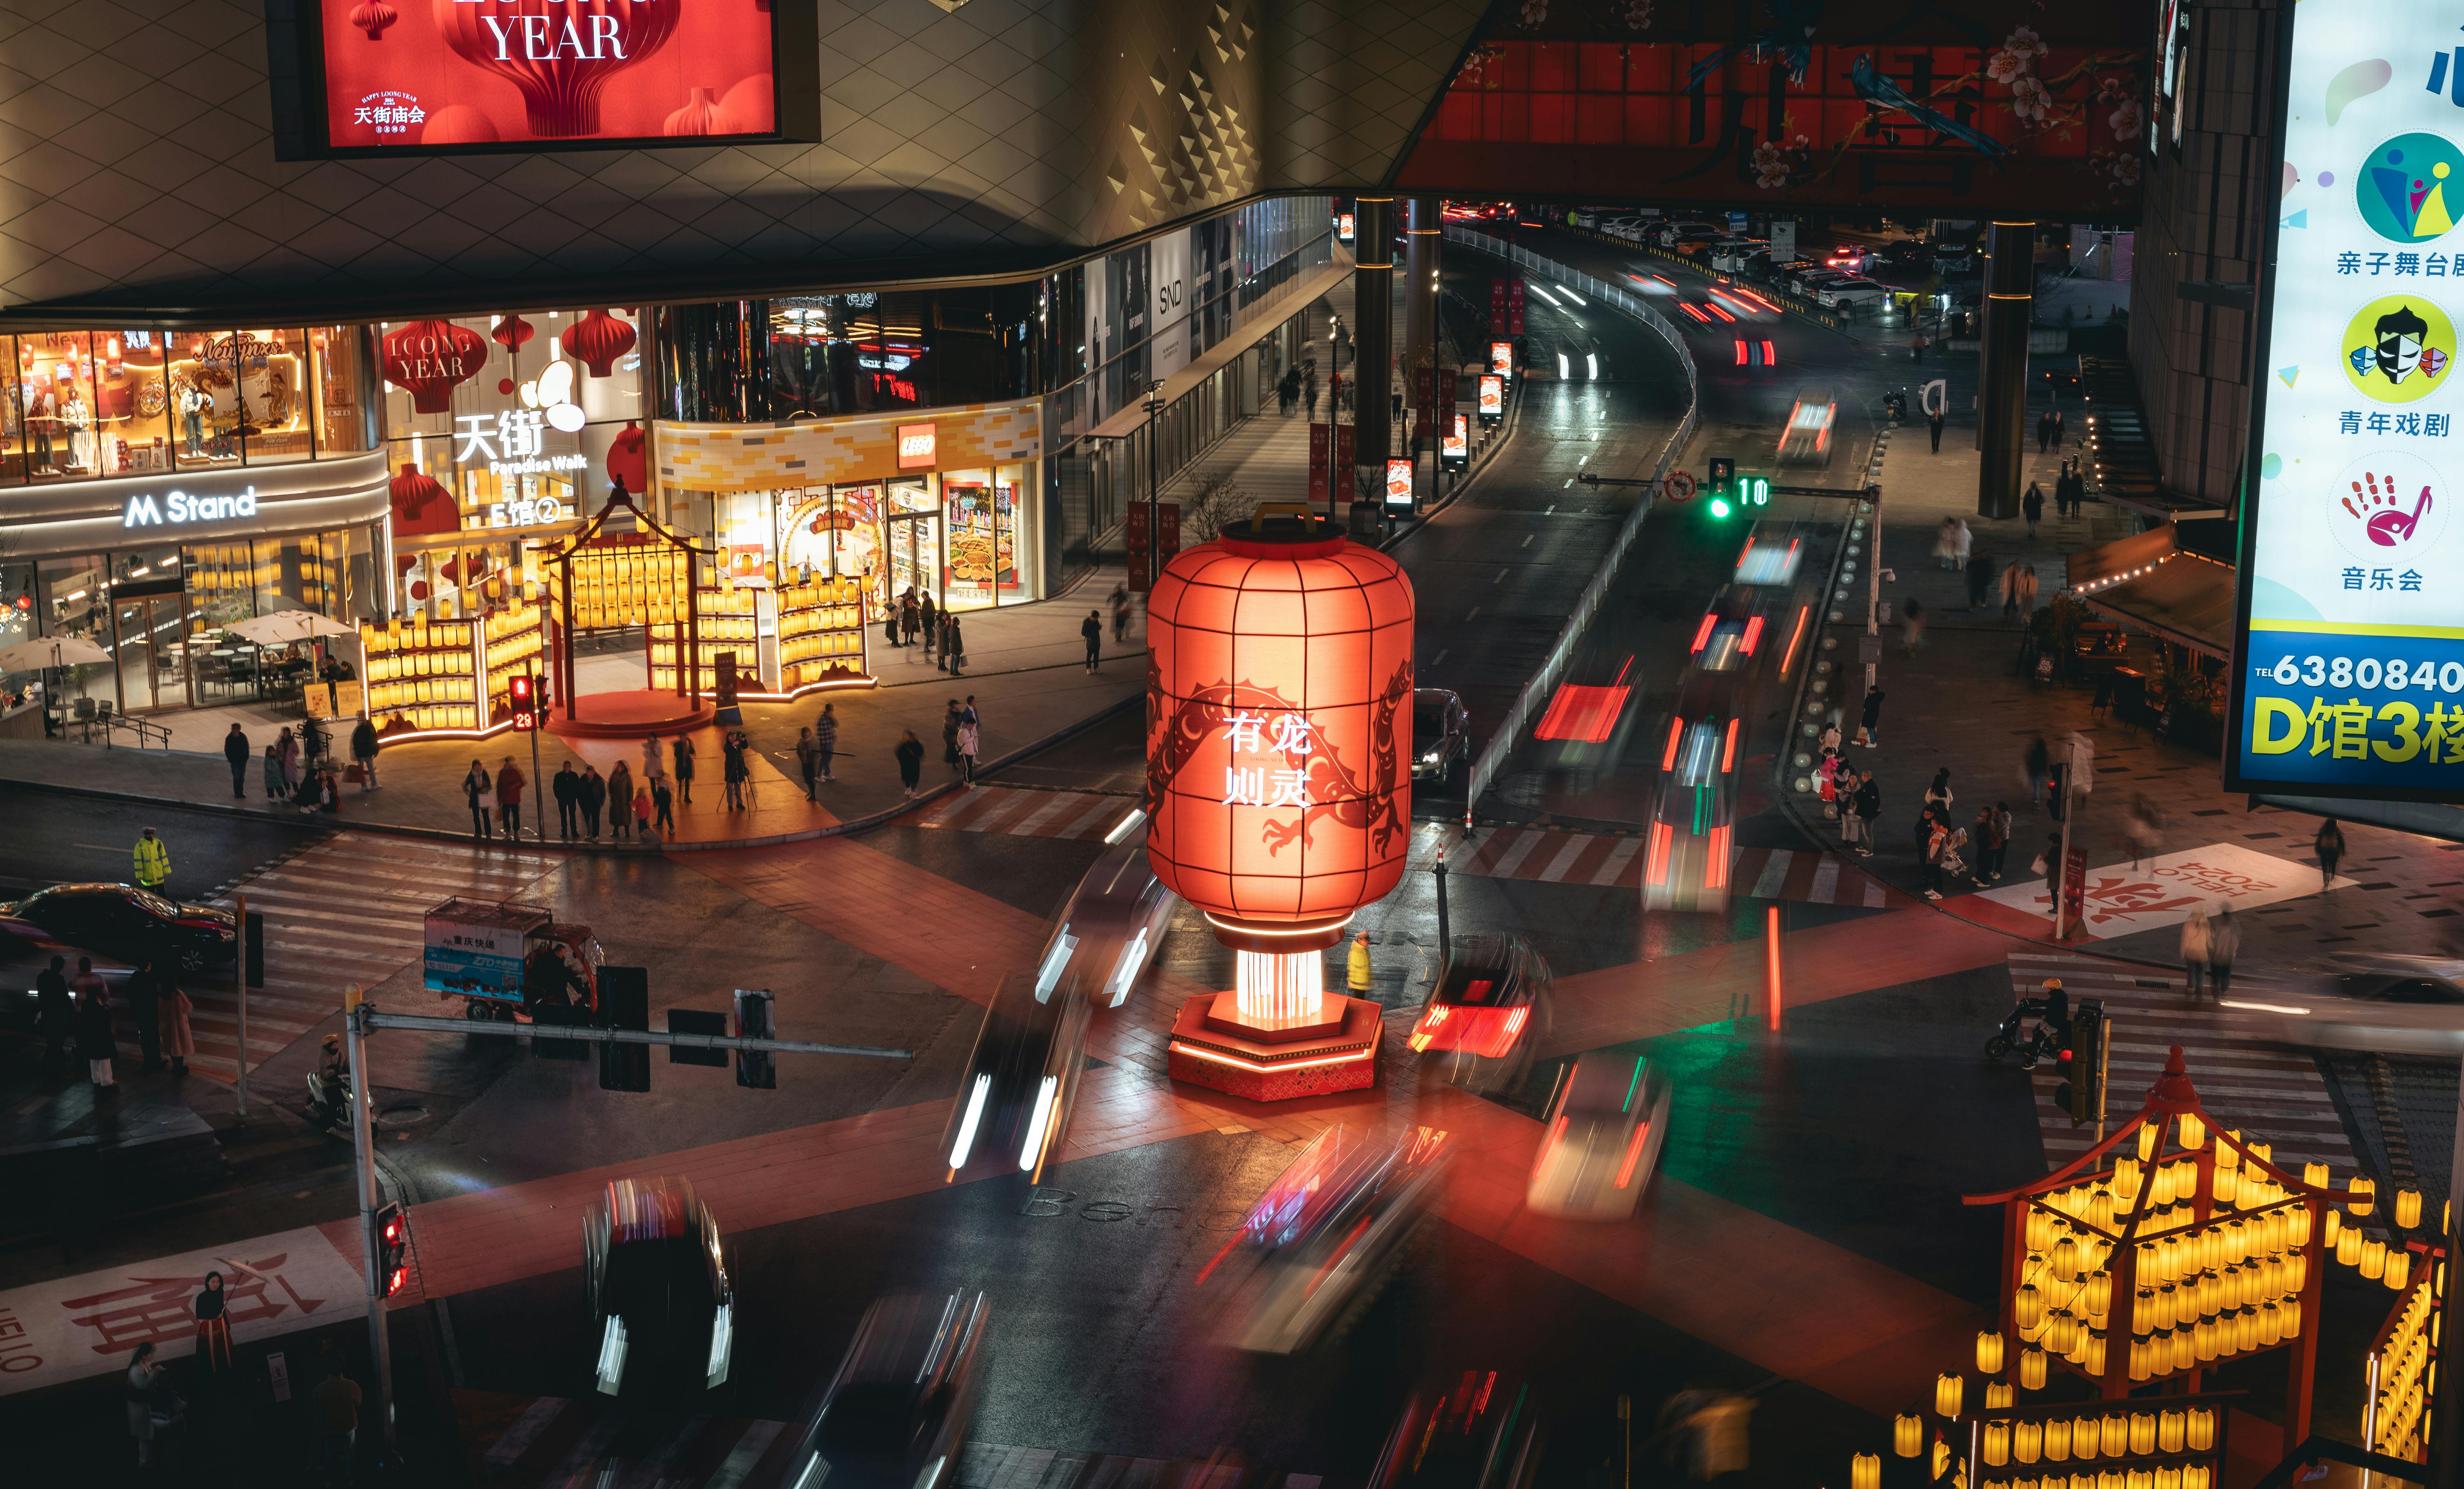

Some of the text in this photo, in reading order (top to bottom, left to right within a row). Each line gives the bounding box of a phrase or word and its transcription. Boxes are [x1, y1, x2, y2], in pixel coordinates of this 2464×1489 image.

[480, 15, 627, 60] YEAR
[361, 92, 379, 104] HAPPY
[402, 92, 417, 103] YEAR
[354, 105, 425, 125] 天街庙会
[1160, 279, 1182, 315] SND
[398, 357, 466, 380] YEAR
[454, 409, 543, 462] 天街
[2339, 410, 2450, 437] 青年戏剧
[901, 437, 934, 455] LEGO
[490, 454, 587, 476] Paradise Walk
[1739, 478, 1767, 506] 10
[125, 486, 255, 527] M Stand
[732, 552, 763, 568] LO
[2342, 566, 2424, 593] 音乐会
[2255, 668, 2273, 678] TEL
[1222, 710, 1313, 755] 有龙
[1221, 766, 1312, 809] 则灵
[2153, 867, 2248, 897] HELLO
[2176, 861, 2278, 892] 2024
[453, 935, 495, 949] 重庆快递
[473, 956, 495, 967] ZTO
